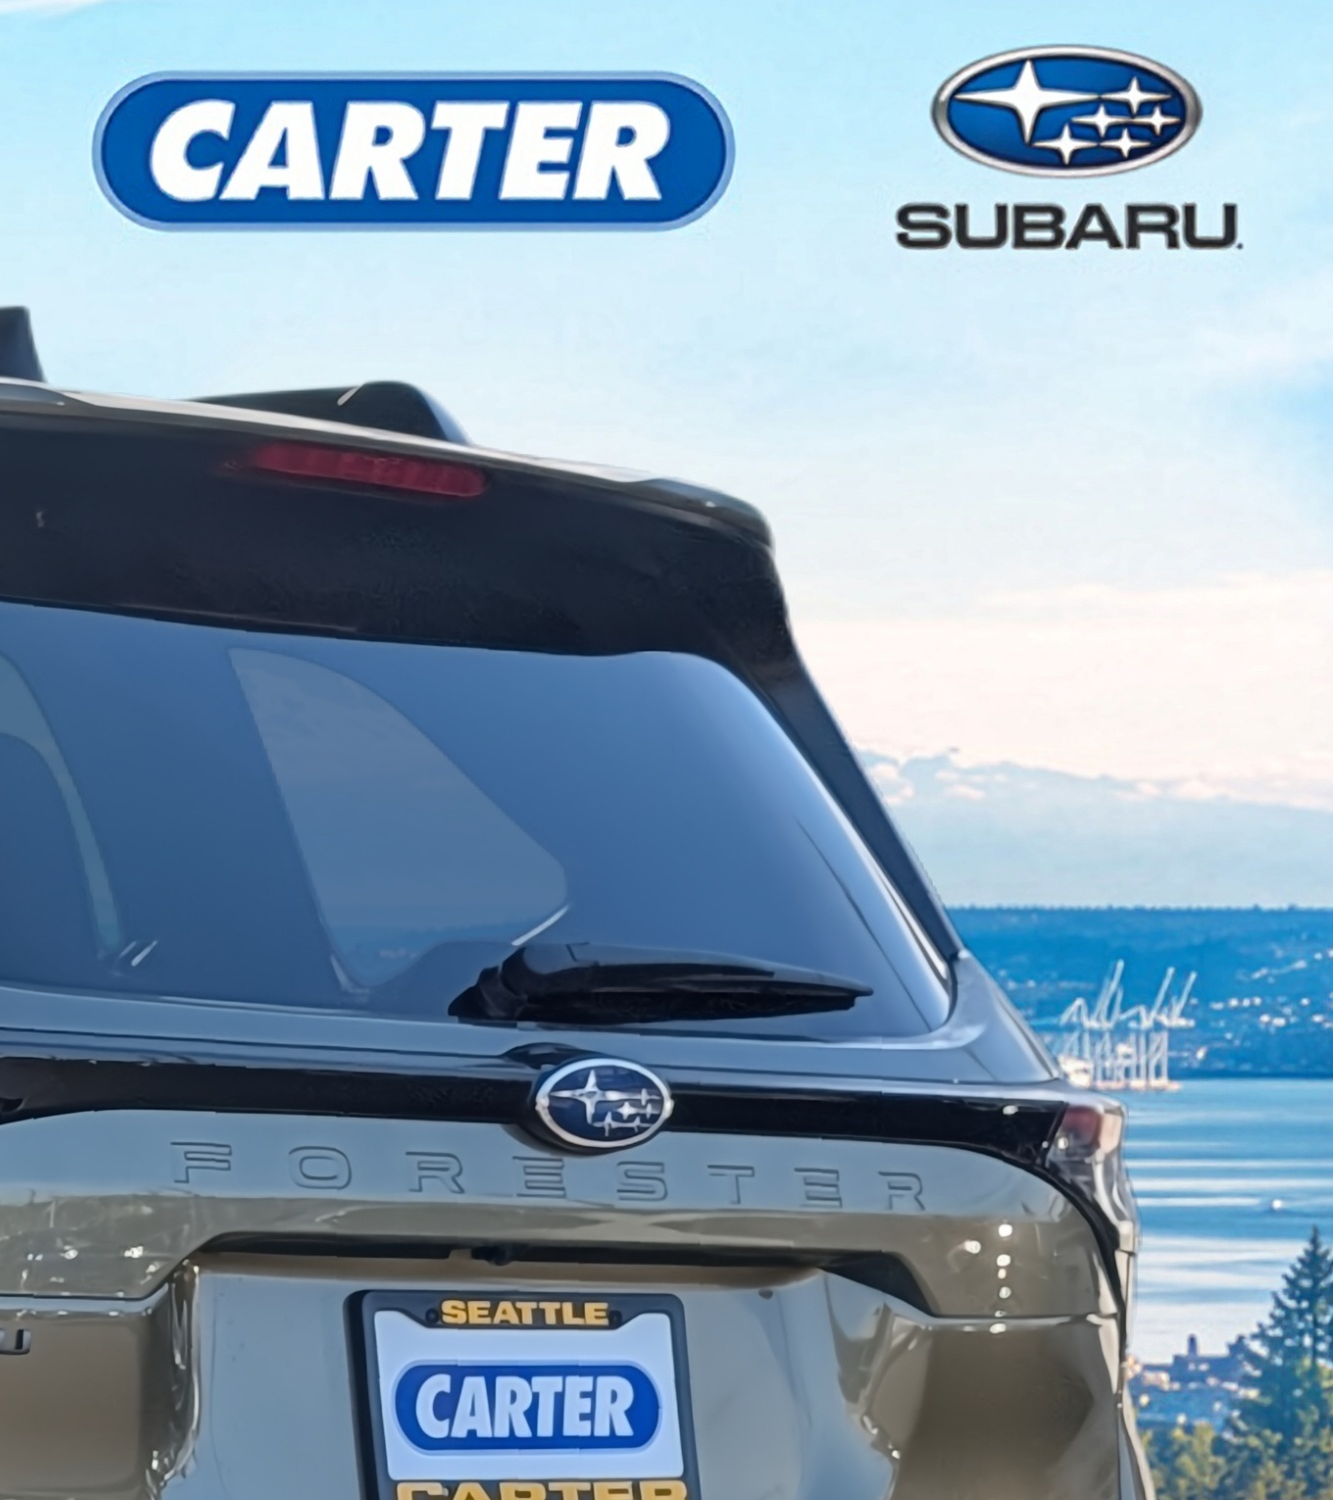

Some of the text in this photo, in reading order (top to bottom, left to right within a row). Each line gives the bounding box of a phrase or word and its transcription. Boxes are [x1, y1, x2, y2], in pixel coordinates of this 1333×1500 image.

[170, 1141, 927, 1211] FORESTER
[441, 1299, 610, 1326] SEATTLE
[415, 1373, 635, 1438] CARTER
